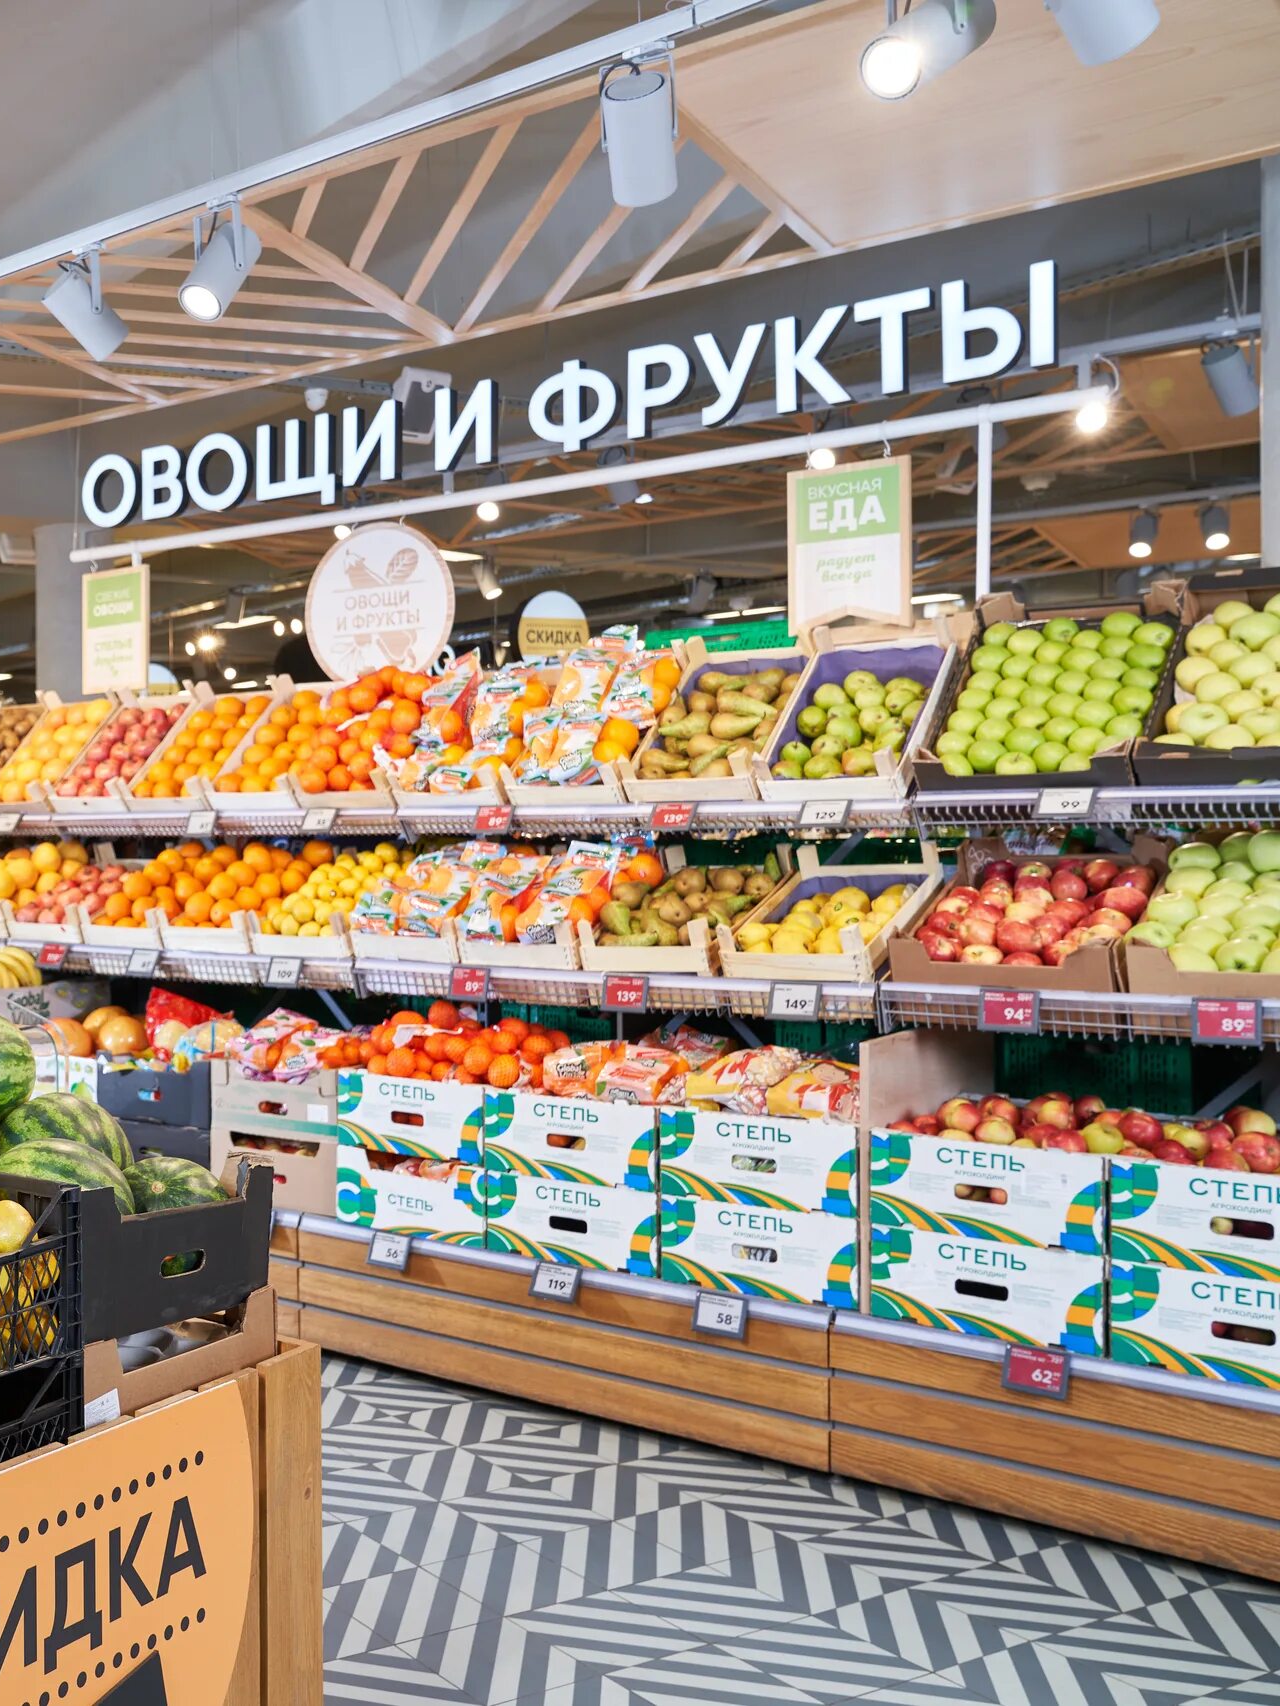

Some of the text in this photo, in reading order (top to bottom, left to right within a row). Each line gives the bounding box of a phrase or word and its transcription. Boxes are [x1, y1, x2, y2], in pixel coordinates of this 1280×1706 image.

[81, 260, 1057, 528] ОВОЩИ И ФРУКТЫ
[808, 477, 882, 500] ВКУСНАЯ
[809, 495, 886, 533] ЕДА
[93, 600, 134, 617] ОВОЩИ
[344, 589, 410, 612] ОВОЩИ
[336, 608, 420, 631] И ФРУКТЫ
[526, 627, 583, 645] СКИДКА
[1061, 800, 1080, 809] 99
[487, 817, 503, 827] 89
[663, 813, 683, 824] 139
[814, 811, 836, 820] 129
[277, 970, 292, 978] 109
[464, 981, 479, 992] 89
[616, 990, 637, 1002] 139
[785, 998, 807, 1009] 149
[1003, 1007, 1024, 1020] 94
[1221, 1018, 1245, 1032] 89
[379, 1082, 435, 1101] СТЕПЬ
[533, 1103, 599, 1124] СТЕПЬ
[716, 1122, 792, 1144] СТЕПЬ
[936, 1147, 1026, 1173] СТЕПЬ
[535, 1185, 601, 1208] СТЕПЬ
[1189, 1178, 1280, 1205] СТЕП
[387, 1192, 433, 1212] СТЕПЬ
[718, 1210, 793, 1235] СТЕПЬ
[385, 1248, 399, 1260] 56
[938, 1242, 1027, 1272] СТЕПЬ
[548, 1278, 567, 1291] 119
[1191, 1281, 1280, 1310] СТЕП
[716, 1312, 733, 1326] 58
[1031, 1368, 1053, 1385] 62
